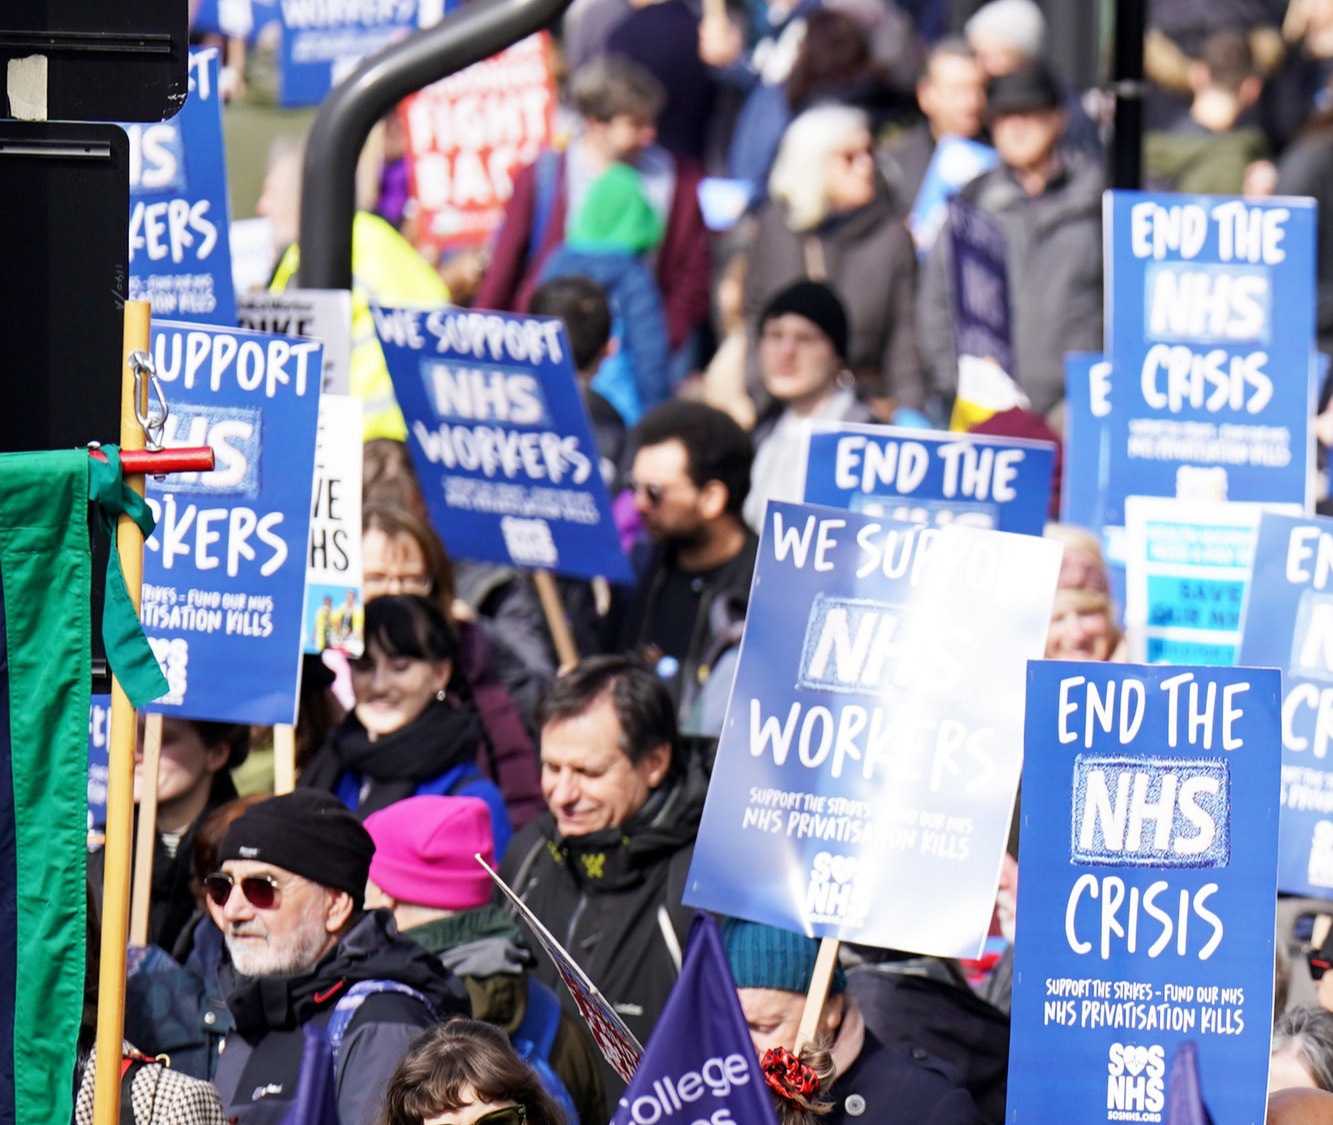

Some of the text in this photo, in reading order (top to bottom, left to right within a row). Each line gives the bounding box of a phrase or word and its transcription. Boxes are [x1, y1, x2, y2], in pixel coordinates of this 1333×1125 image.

[1131, 201, 1290, 265] END THE
[1149, 269, 1268, 338] NHS
[370, 309, 425, 349] WE
[426, 311, 563, 366] SUPPORT
[431, 364, 543, 425] NHS
[1140, 343, 1274, 414] CRISIS
[413, 420, 591, 485] WORKERS
[834, 436, 1026, 502] END THE
[773, 512, 846, 571] WE
[187, 589, 220, 608] FUND
[221, 592, 246, 611] OUR
[226, 610, 273, 637] KILLS
[1058, 672, 1250, 751] END THE
[749, 786, 802, 818] SUPPORT
[803, 793, 824, 813] THE
[1079, 769, 1220, 855] NHS
[742, 806, 783, 834] NHS
[919, 826, 970, 861] KILLS
[1065, 873, 1224, 961] CRISIS
[1044, 1000, 1245, 1035] NHS PRIVATISATION KILLS
[1045, 978, 1245, 1006] SUPPORT THE STRIKES FUND OUR NHS
[1106, 1075, 1165, 1112] NHS
[1107, 1110, 1162, 1123] SOSNHS.ORG
